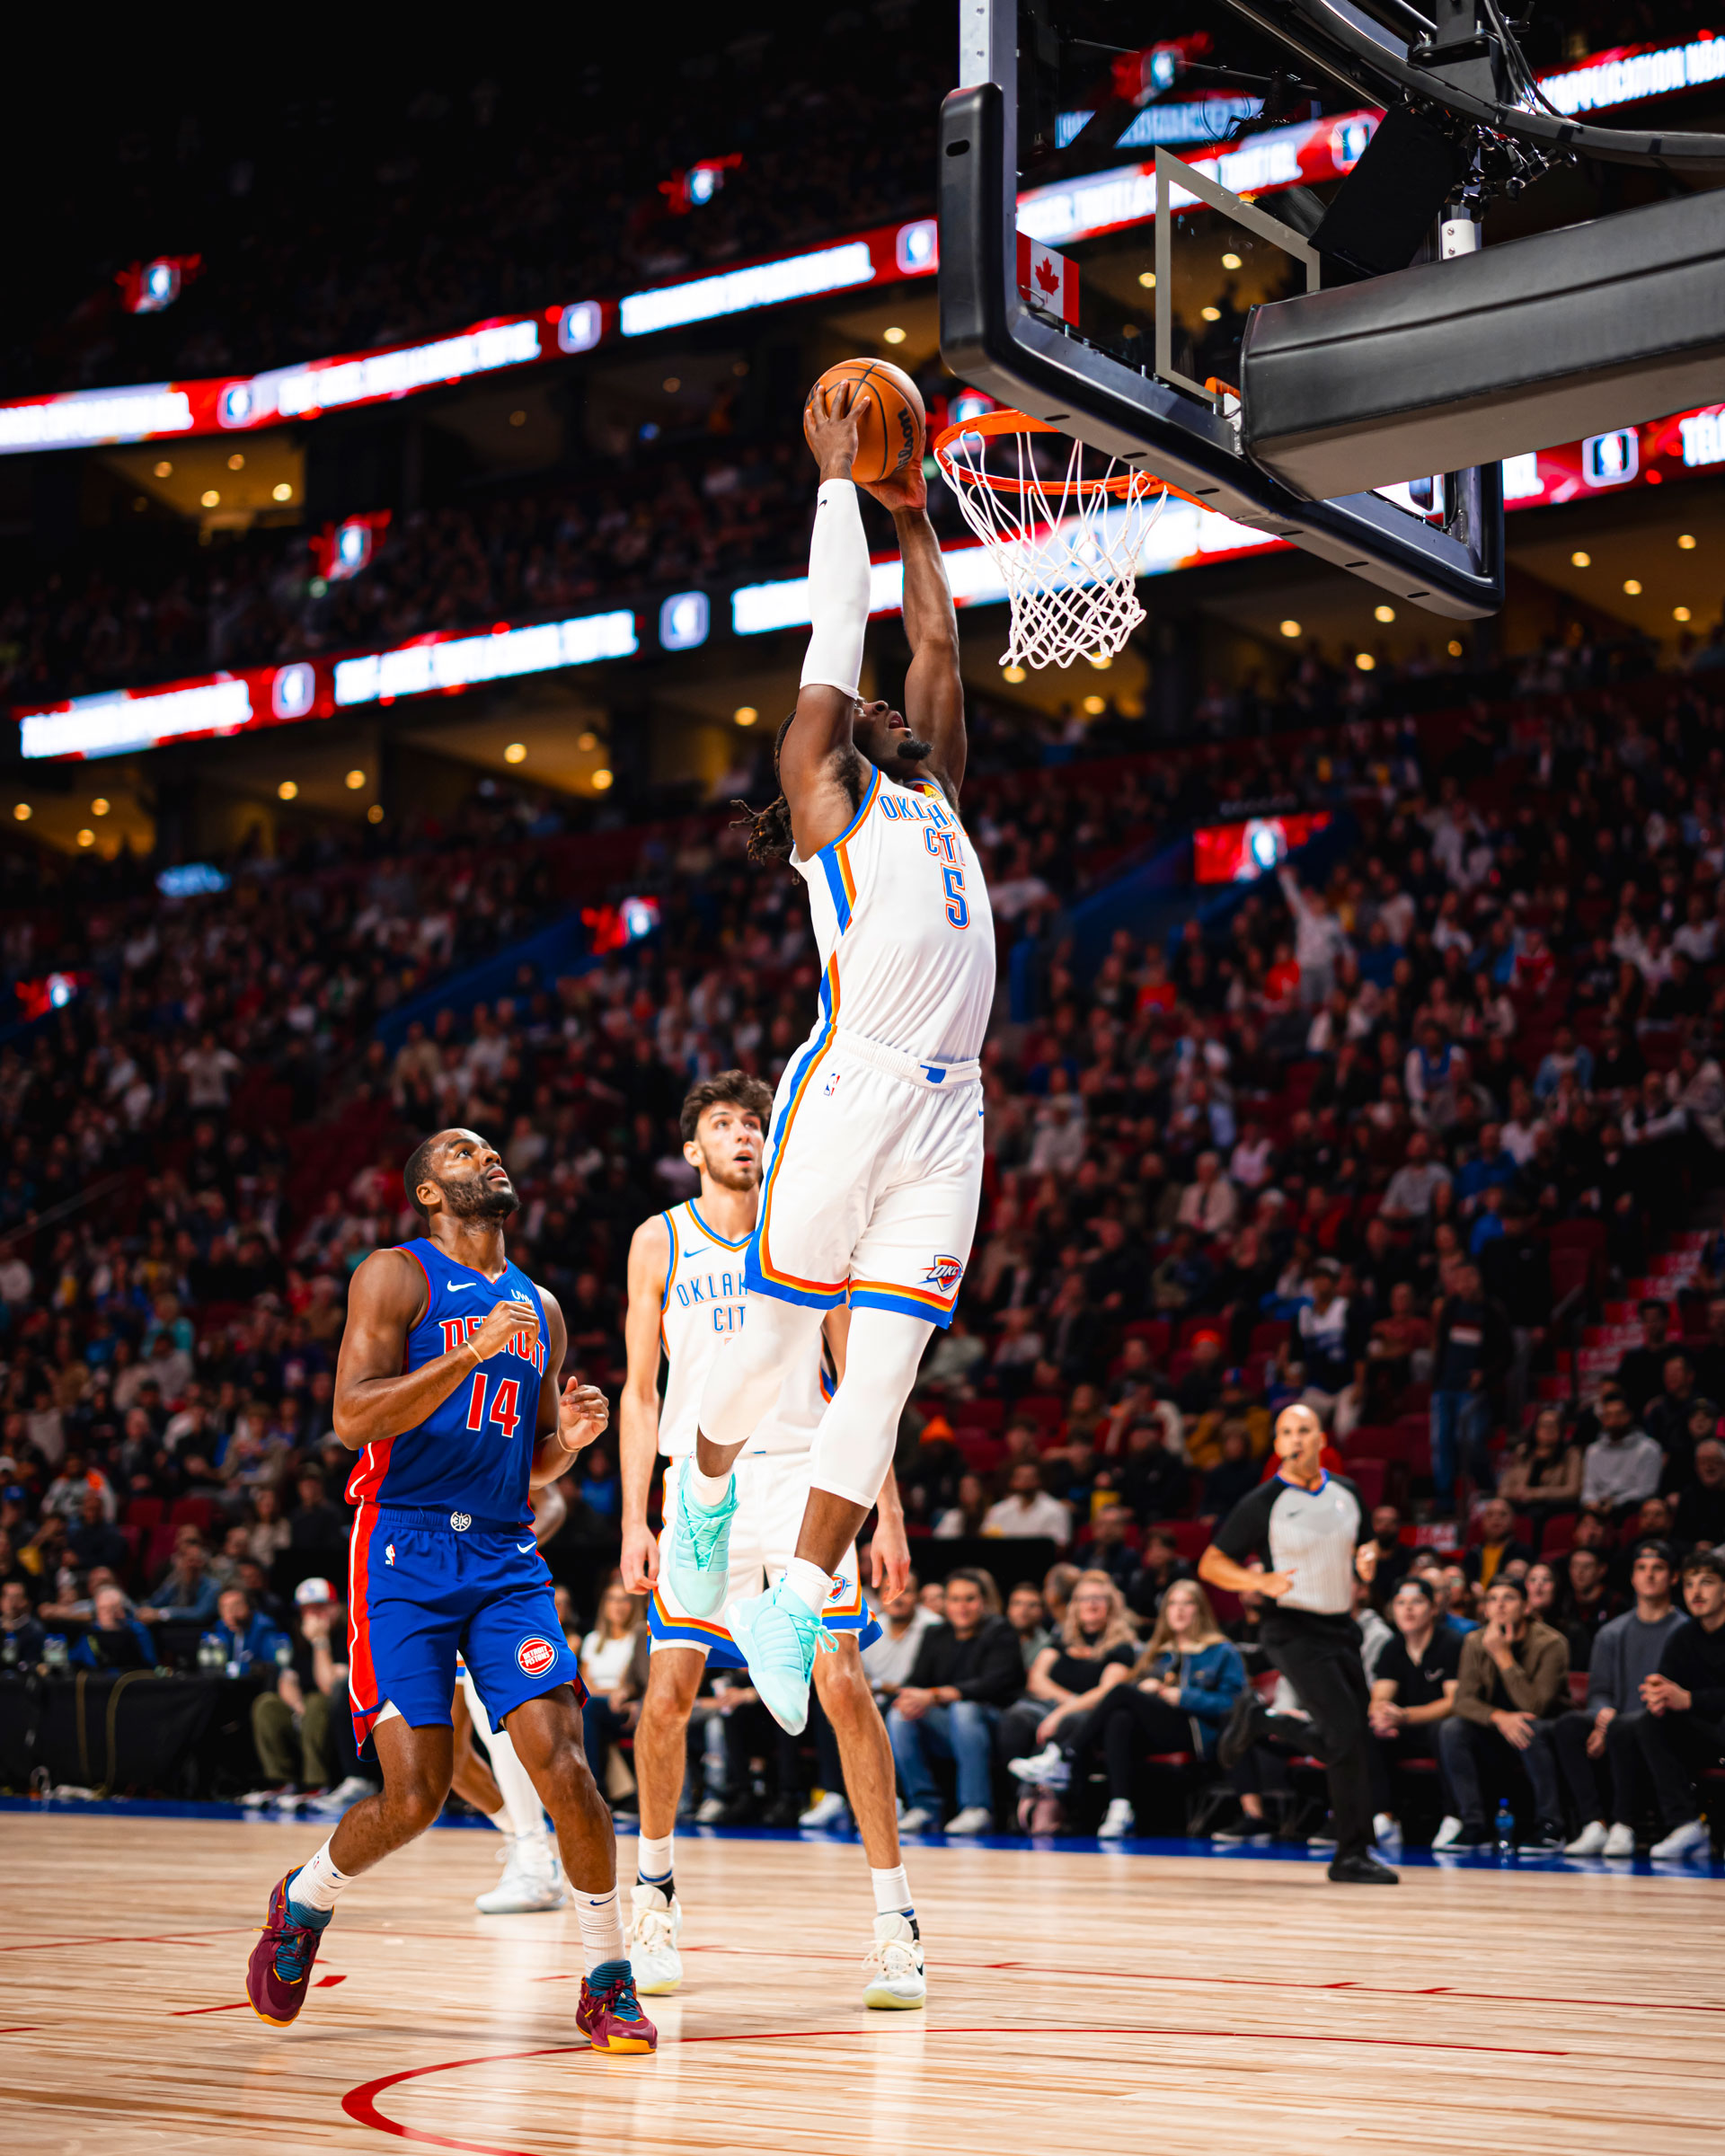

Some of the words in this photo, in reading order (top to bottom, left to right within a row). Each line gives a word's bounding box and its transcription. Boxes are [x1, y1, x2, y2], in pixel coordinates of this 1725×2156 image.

[890, 407, 914, 473] ilson
[941, 862, 969, 930] 5
[466, 1372, 521, 1438] 14
